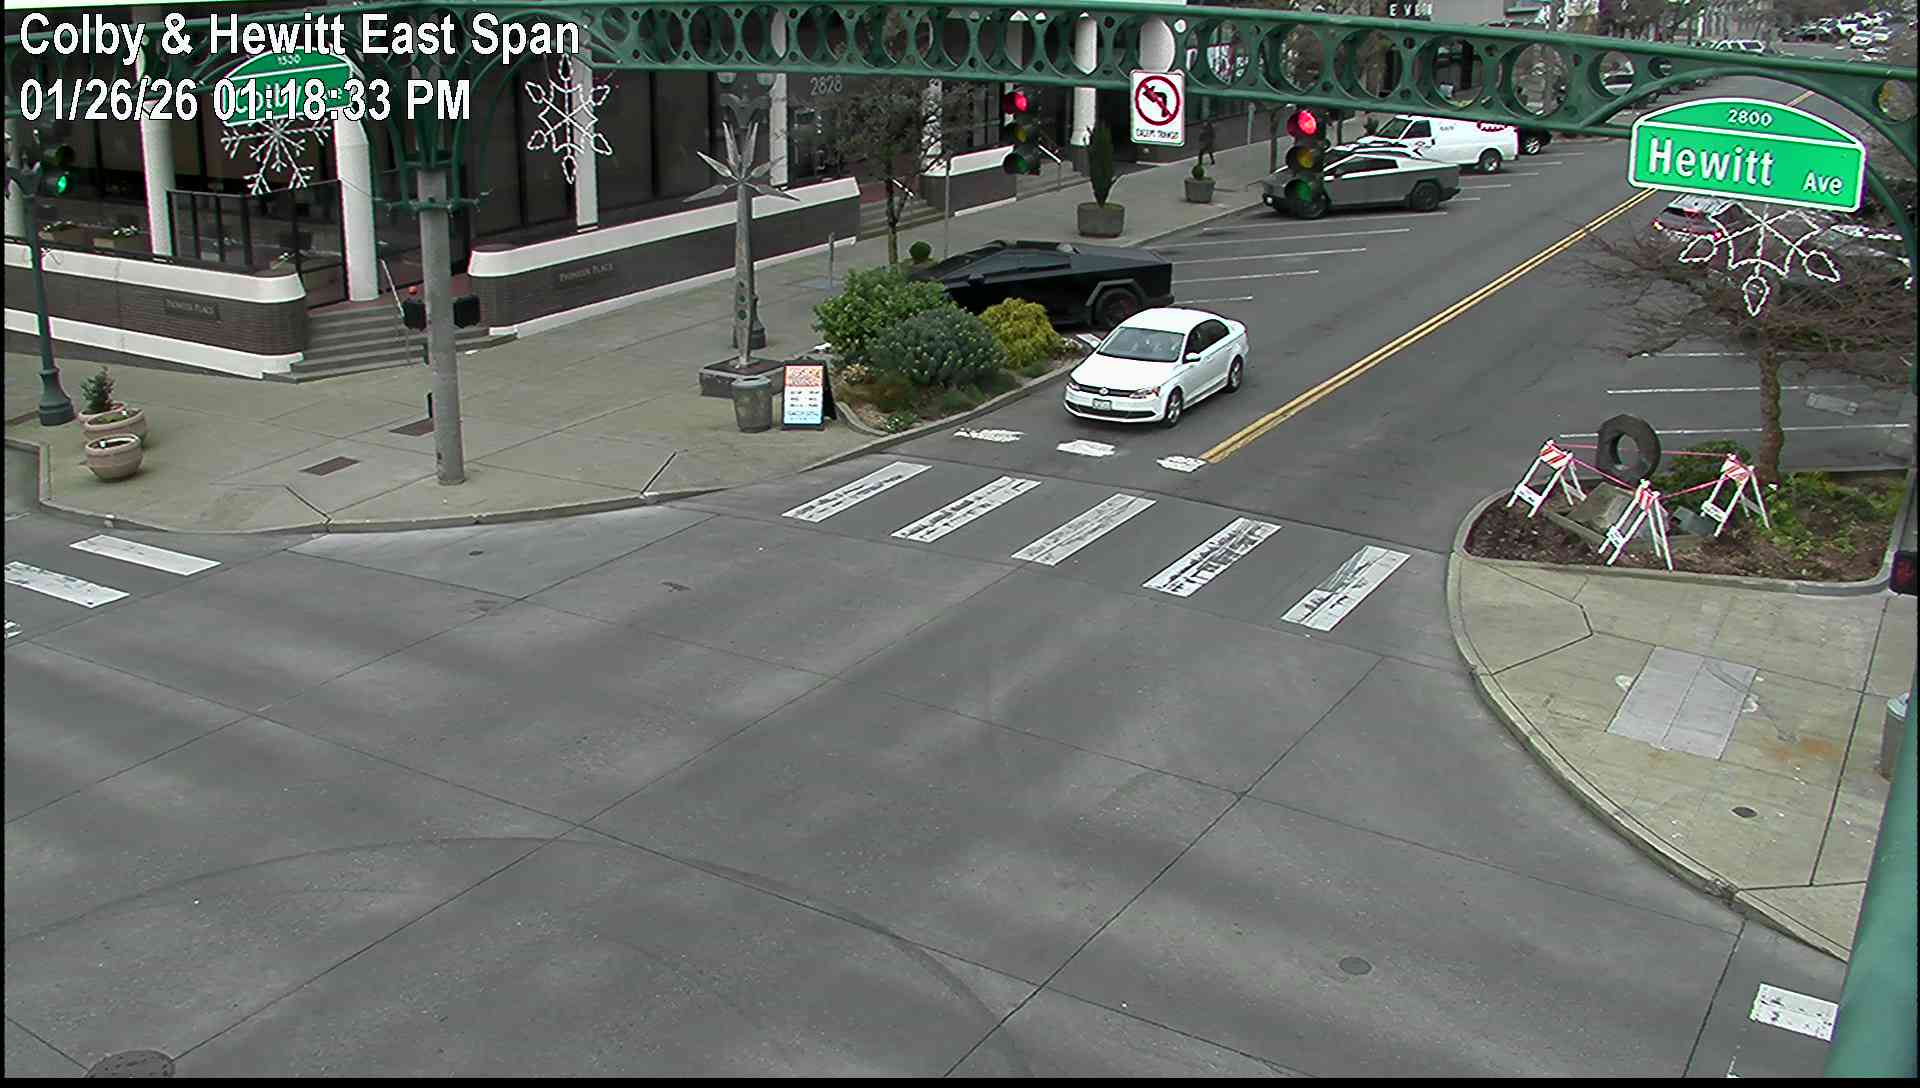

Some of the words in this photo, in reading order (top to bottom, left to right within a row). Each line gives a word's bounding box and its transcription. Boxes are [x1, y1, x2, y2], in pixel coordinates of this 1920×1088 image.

[1727, 108, 1773, 127] 2800
[1648, 136, 1775, 186] Hewitt
[1802, 171, 1844, 195] Ave
